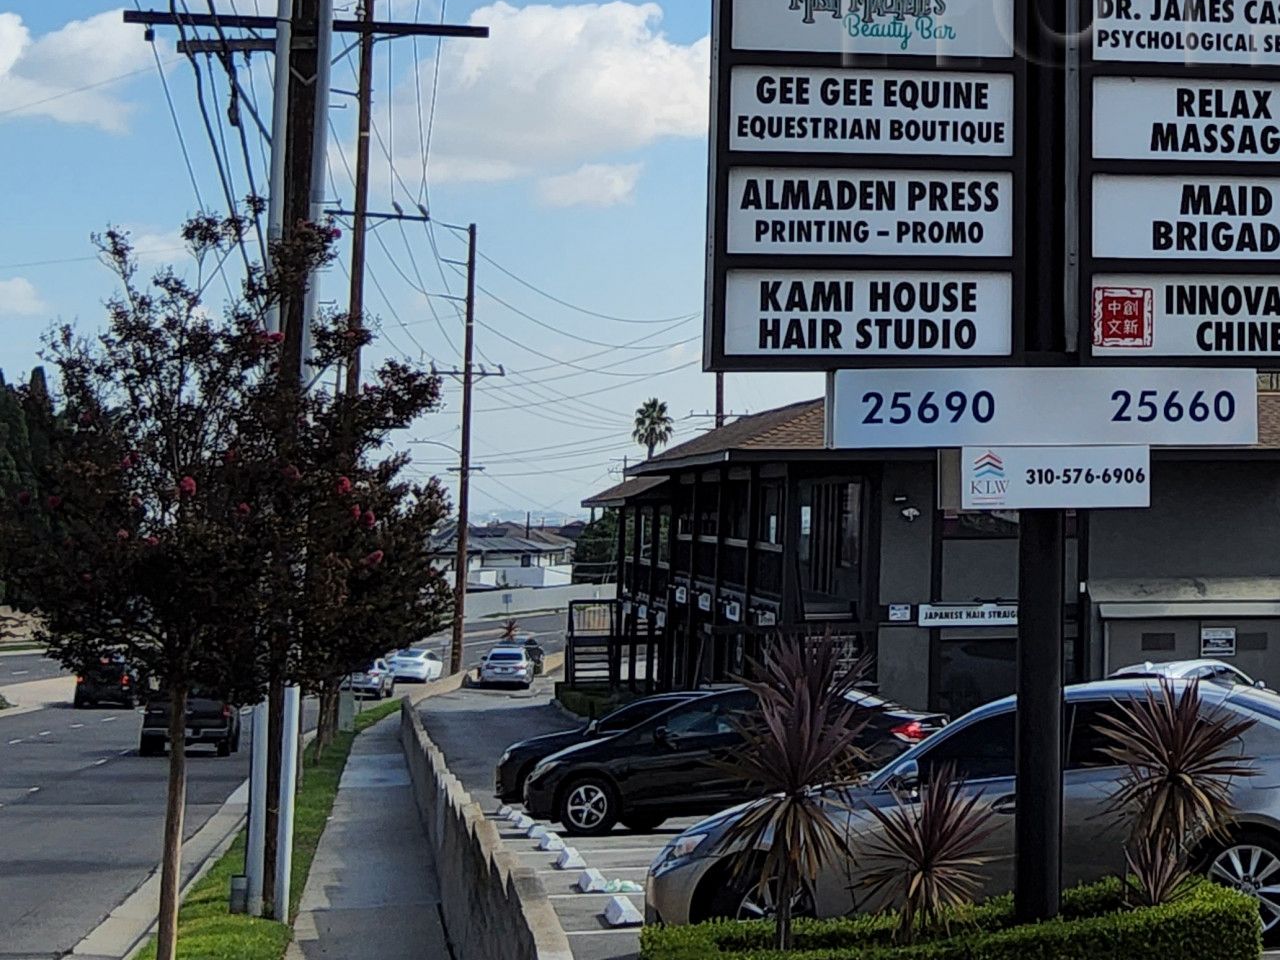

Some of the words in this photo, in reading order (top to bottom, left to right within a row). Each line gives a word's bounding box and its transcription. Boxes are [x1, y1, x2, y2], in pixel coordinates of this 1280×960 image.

[844, 14, 912, 50] Beauty
[915, 16, 957, 41] Bar
[1096, 30, 1258, 53] PSYCHOLOGICAL
[755, 75, 809, 104] GEE
[819, 77, 874, 106] GEE
[883, 80, 989, 112] EQUINE
[1175, 88, 1272, 120] RELAX
[736, 116, 881, 141] EQUESTRIAN
[889, 119, 1005, 144] BOUTIQUE
[740, 179, 897, 211] ALMADEN
[907, 180, 1000, 212] PRESS
[1180, 184, 1273, 216] MAID
[755, 220, 870, 243] PRINTING
[896, 222, 984, 244] PROMO
[759, 280, 853, 312] KAMI
[869, 281, 978, 313] HOUSE
[758, 319, 842, 350] HAIR
[855, 318, 978, 350] STUDIO
[861, 390, 996, 425] 25690
[1109, 389, 1236, 424] 25660
[1025, 467, 1146, 485] 310-576-6906
[924, 611, 963, 620] JAPANESE
[966, 610, 985, 619] HAIR
